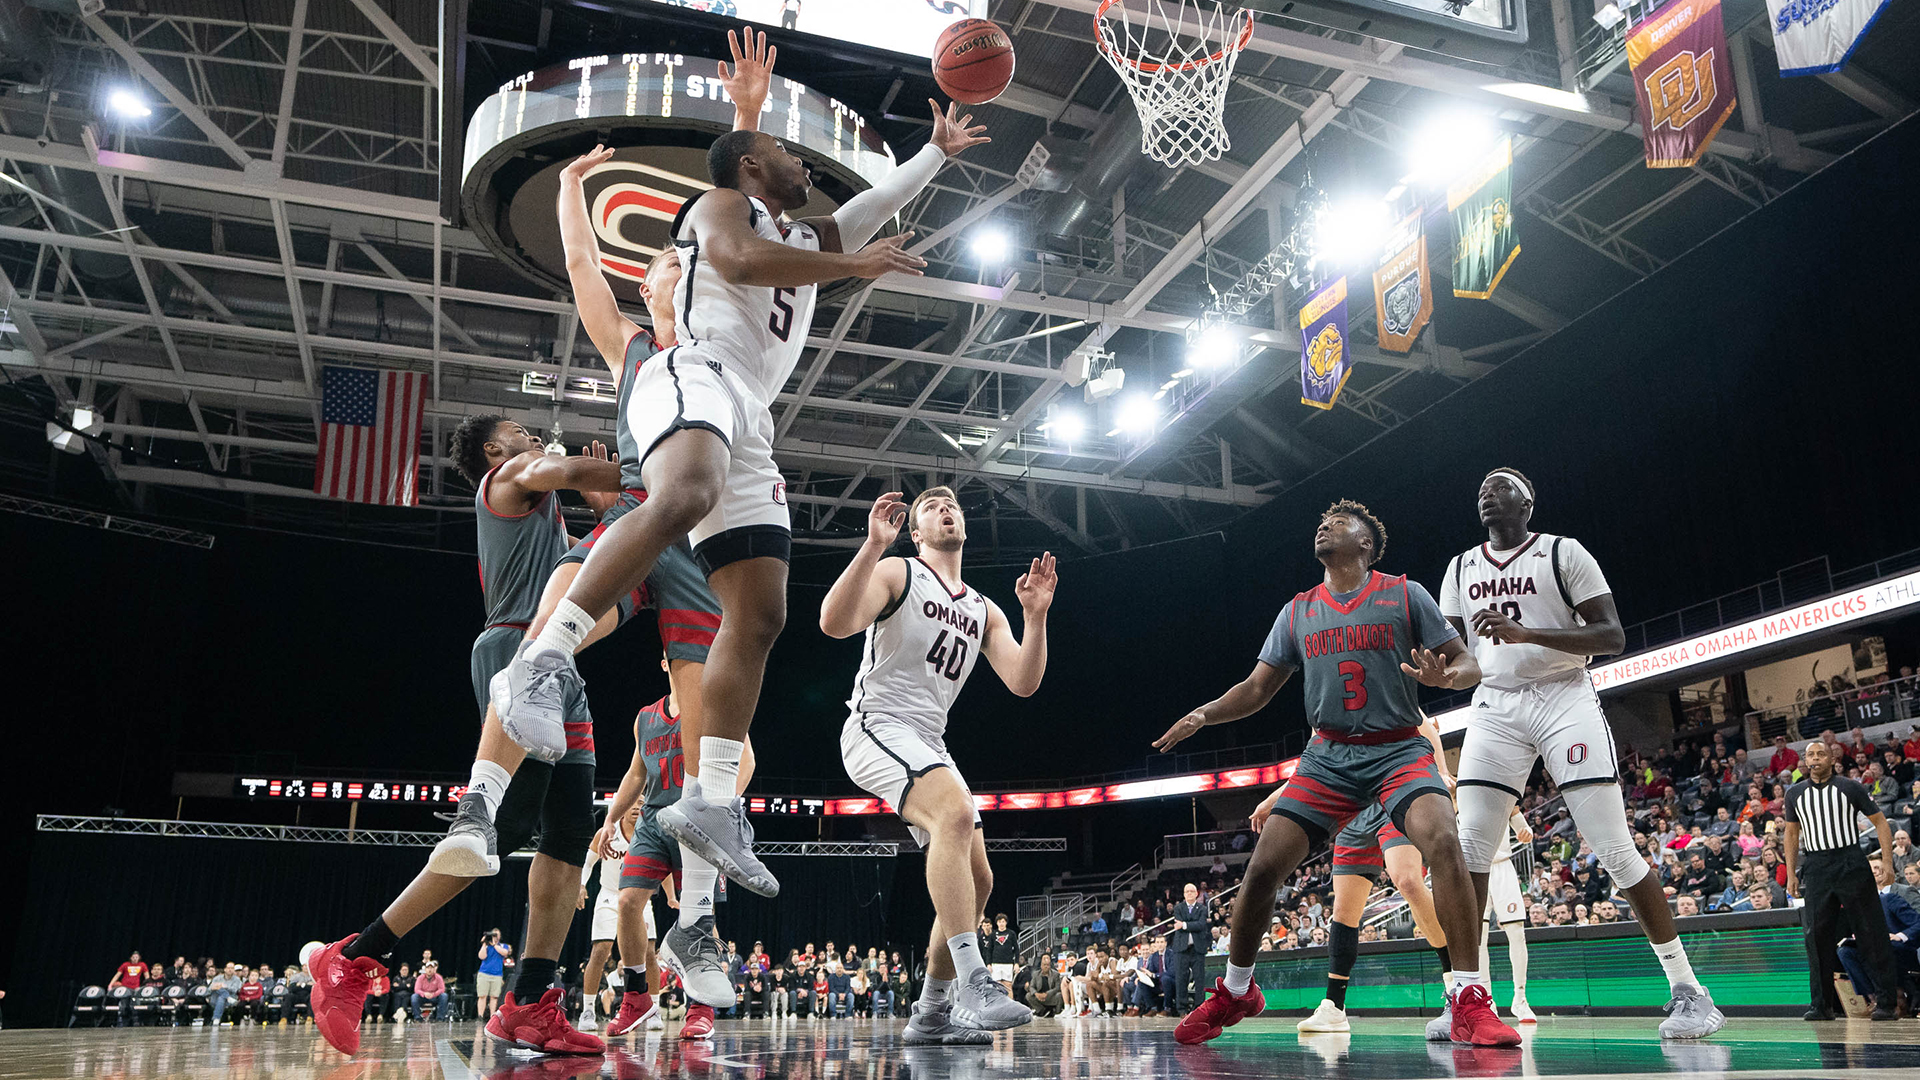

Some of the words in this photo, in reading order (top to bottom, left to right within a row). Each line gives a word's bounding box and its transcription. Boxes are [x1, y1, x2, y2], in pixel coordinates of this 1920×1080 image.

[1650, 5, 1693, 43] DENVER
[568, 54, 609, 70] OMAHA
[622, 53, 647, 65] PTS
[654, 52, 684, 66] FLS
[952, 33, 1005, 57] Wilson
[685, 74, 774, 112] STS
[1643, 47, 1718, 131] DU
[830, 97, 848, 116] PTS
[849, 109, 865, 128] FLS
[1381, 250, 1419, 285] PURDUE
[768, 286, 797, 343] 5
[1468, 576, 1538, 602] OMAHA
[922, 600, 979, 640] OMAHA
[1592, 670, 1610, 687] OF
[1614, 647, 1690, 681] NEBRASKA
[1695, 628, 1758, 658] OMAHA
[1763, 594, 1867, 639] MAVERICKS
[1875, 580, 1920, 608] ATHL
[925, 629, 969, 682] 40
[1304, 626, 1346, 660] SOUTH
[1345, 623, 1396, 653] DAKOTA
[1337, 659, 1369, 712] 3
[1857, 701, 1882, 720] 115
[645, 733, 671, 757] SOUTH
[658, 754, 685, 790] 10
[1203, 841, 1217, 851] 113
